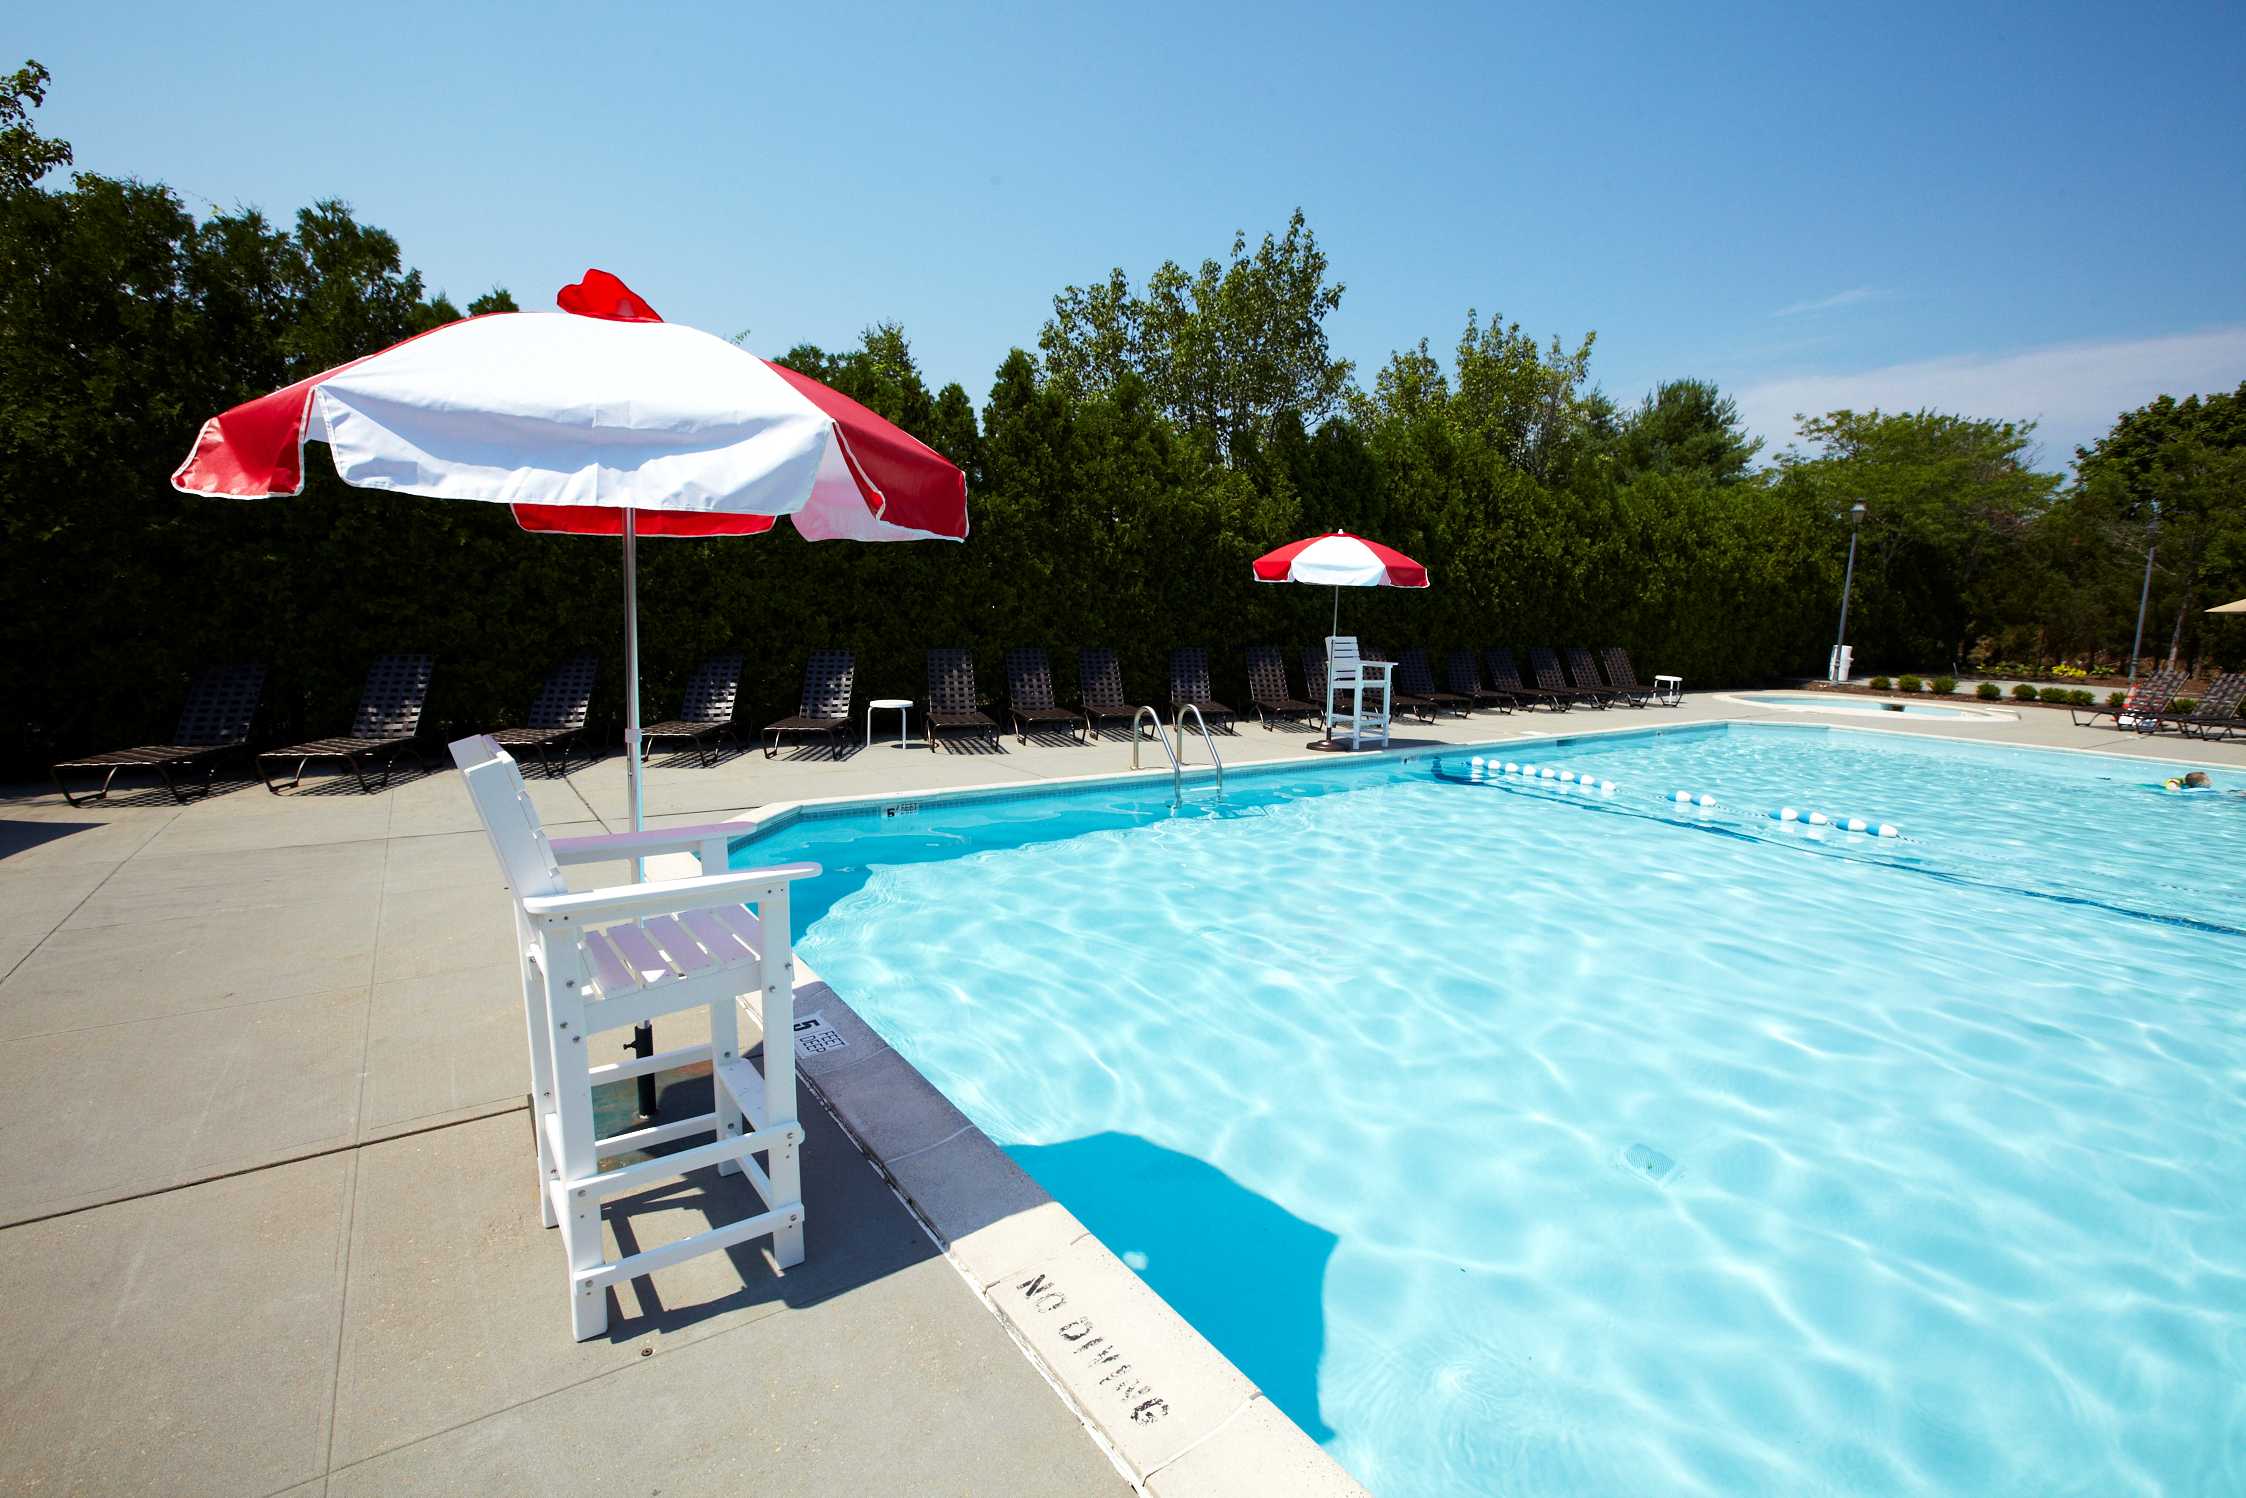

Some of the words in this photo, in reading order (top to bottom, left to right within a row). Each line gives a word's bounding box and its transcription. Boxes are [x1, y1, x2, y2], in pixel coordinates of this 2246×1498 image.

[793, 1019, 820, 1032] 5
[799, 1034, 827, 1053] DEEP
[818, 1030, 846, 1048] FEET
[1016, 1273, 1066, 1314] NO
